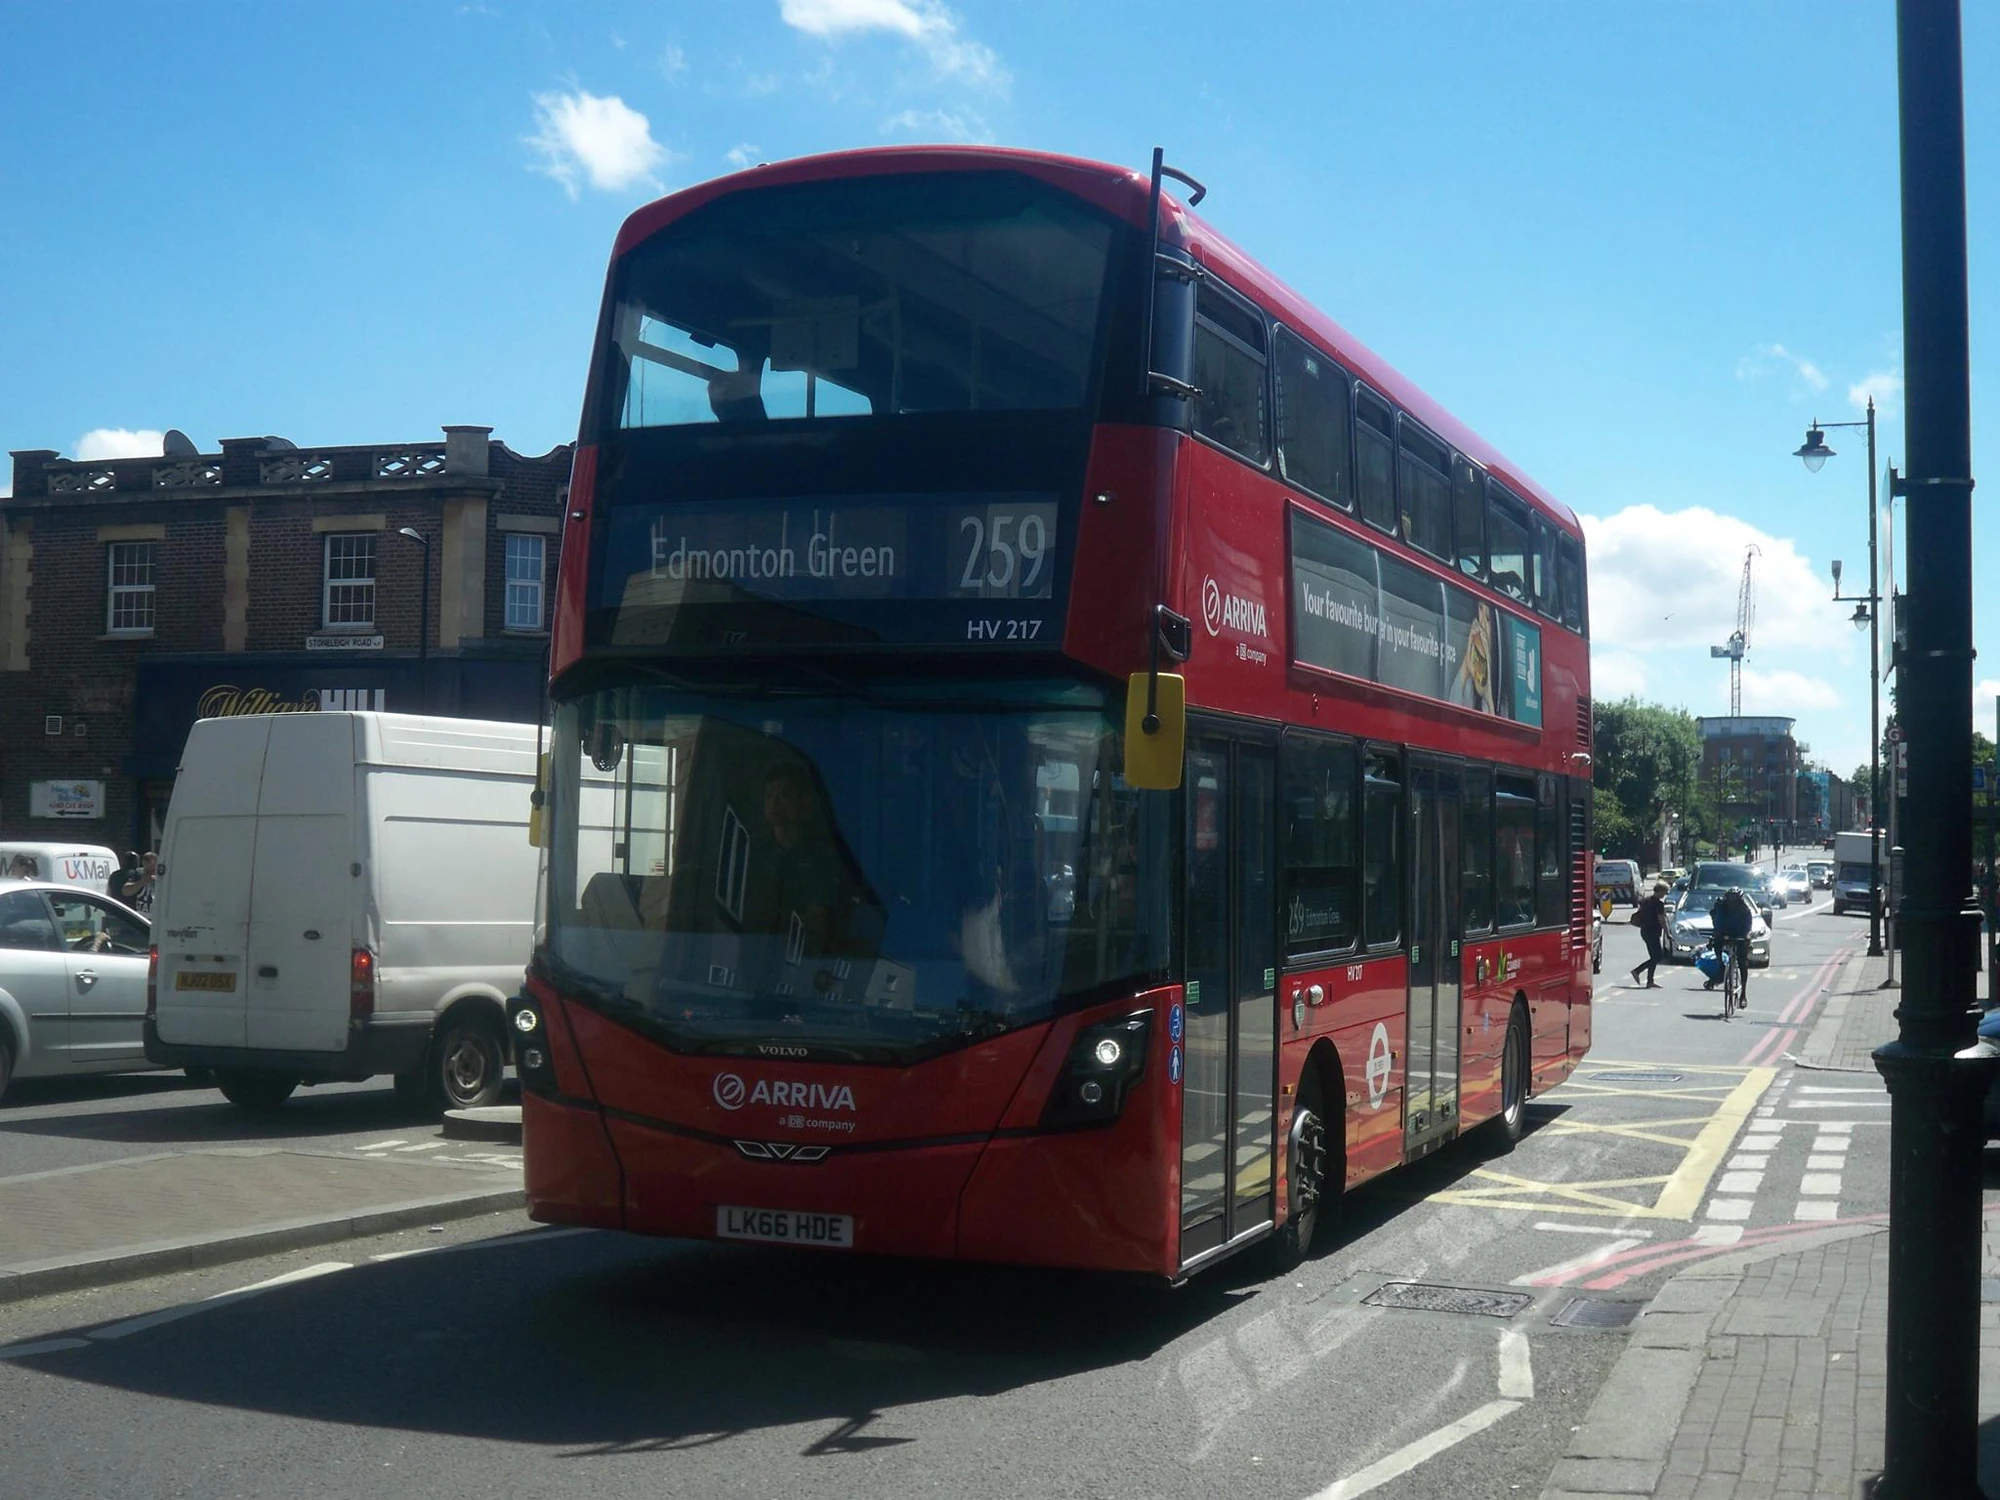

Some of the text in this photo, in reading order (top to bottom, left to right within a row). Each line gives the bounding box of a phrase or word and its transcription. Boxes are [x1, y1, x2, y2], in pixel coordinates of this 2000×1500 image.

[651, 514, 1047, 588] Edmonton Green 259
[1223, 594, 1267, 638] ARRIVA
[1303, 582, 1325, 617] Your
[1326, 590, 1363, 631] favourite
[1364, 606, 1387, 642] burer
[1394, 625, 1410, 652] your
[1411, 625, 1439, 657] favourite
[967, 619, 1042, 640] HV 217
[308, 640, 350, 648] STONELEIGH
[353, 639, 372, 647] ROAD
[1247, 649, 1267, 667] company
[197, 684, 320, 717] William
[1888, 728, 1900, 741] G
[758, 1045, 808, 1057] VOLVO
[750, 1080, 856, 1111] ARRIVA
[779, 1115, 856, 1132] a DB company
[727, 1209, 843, 1242] LK66 HDE
